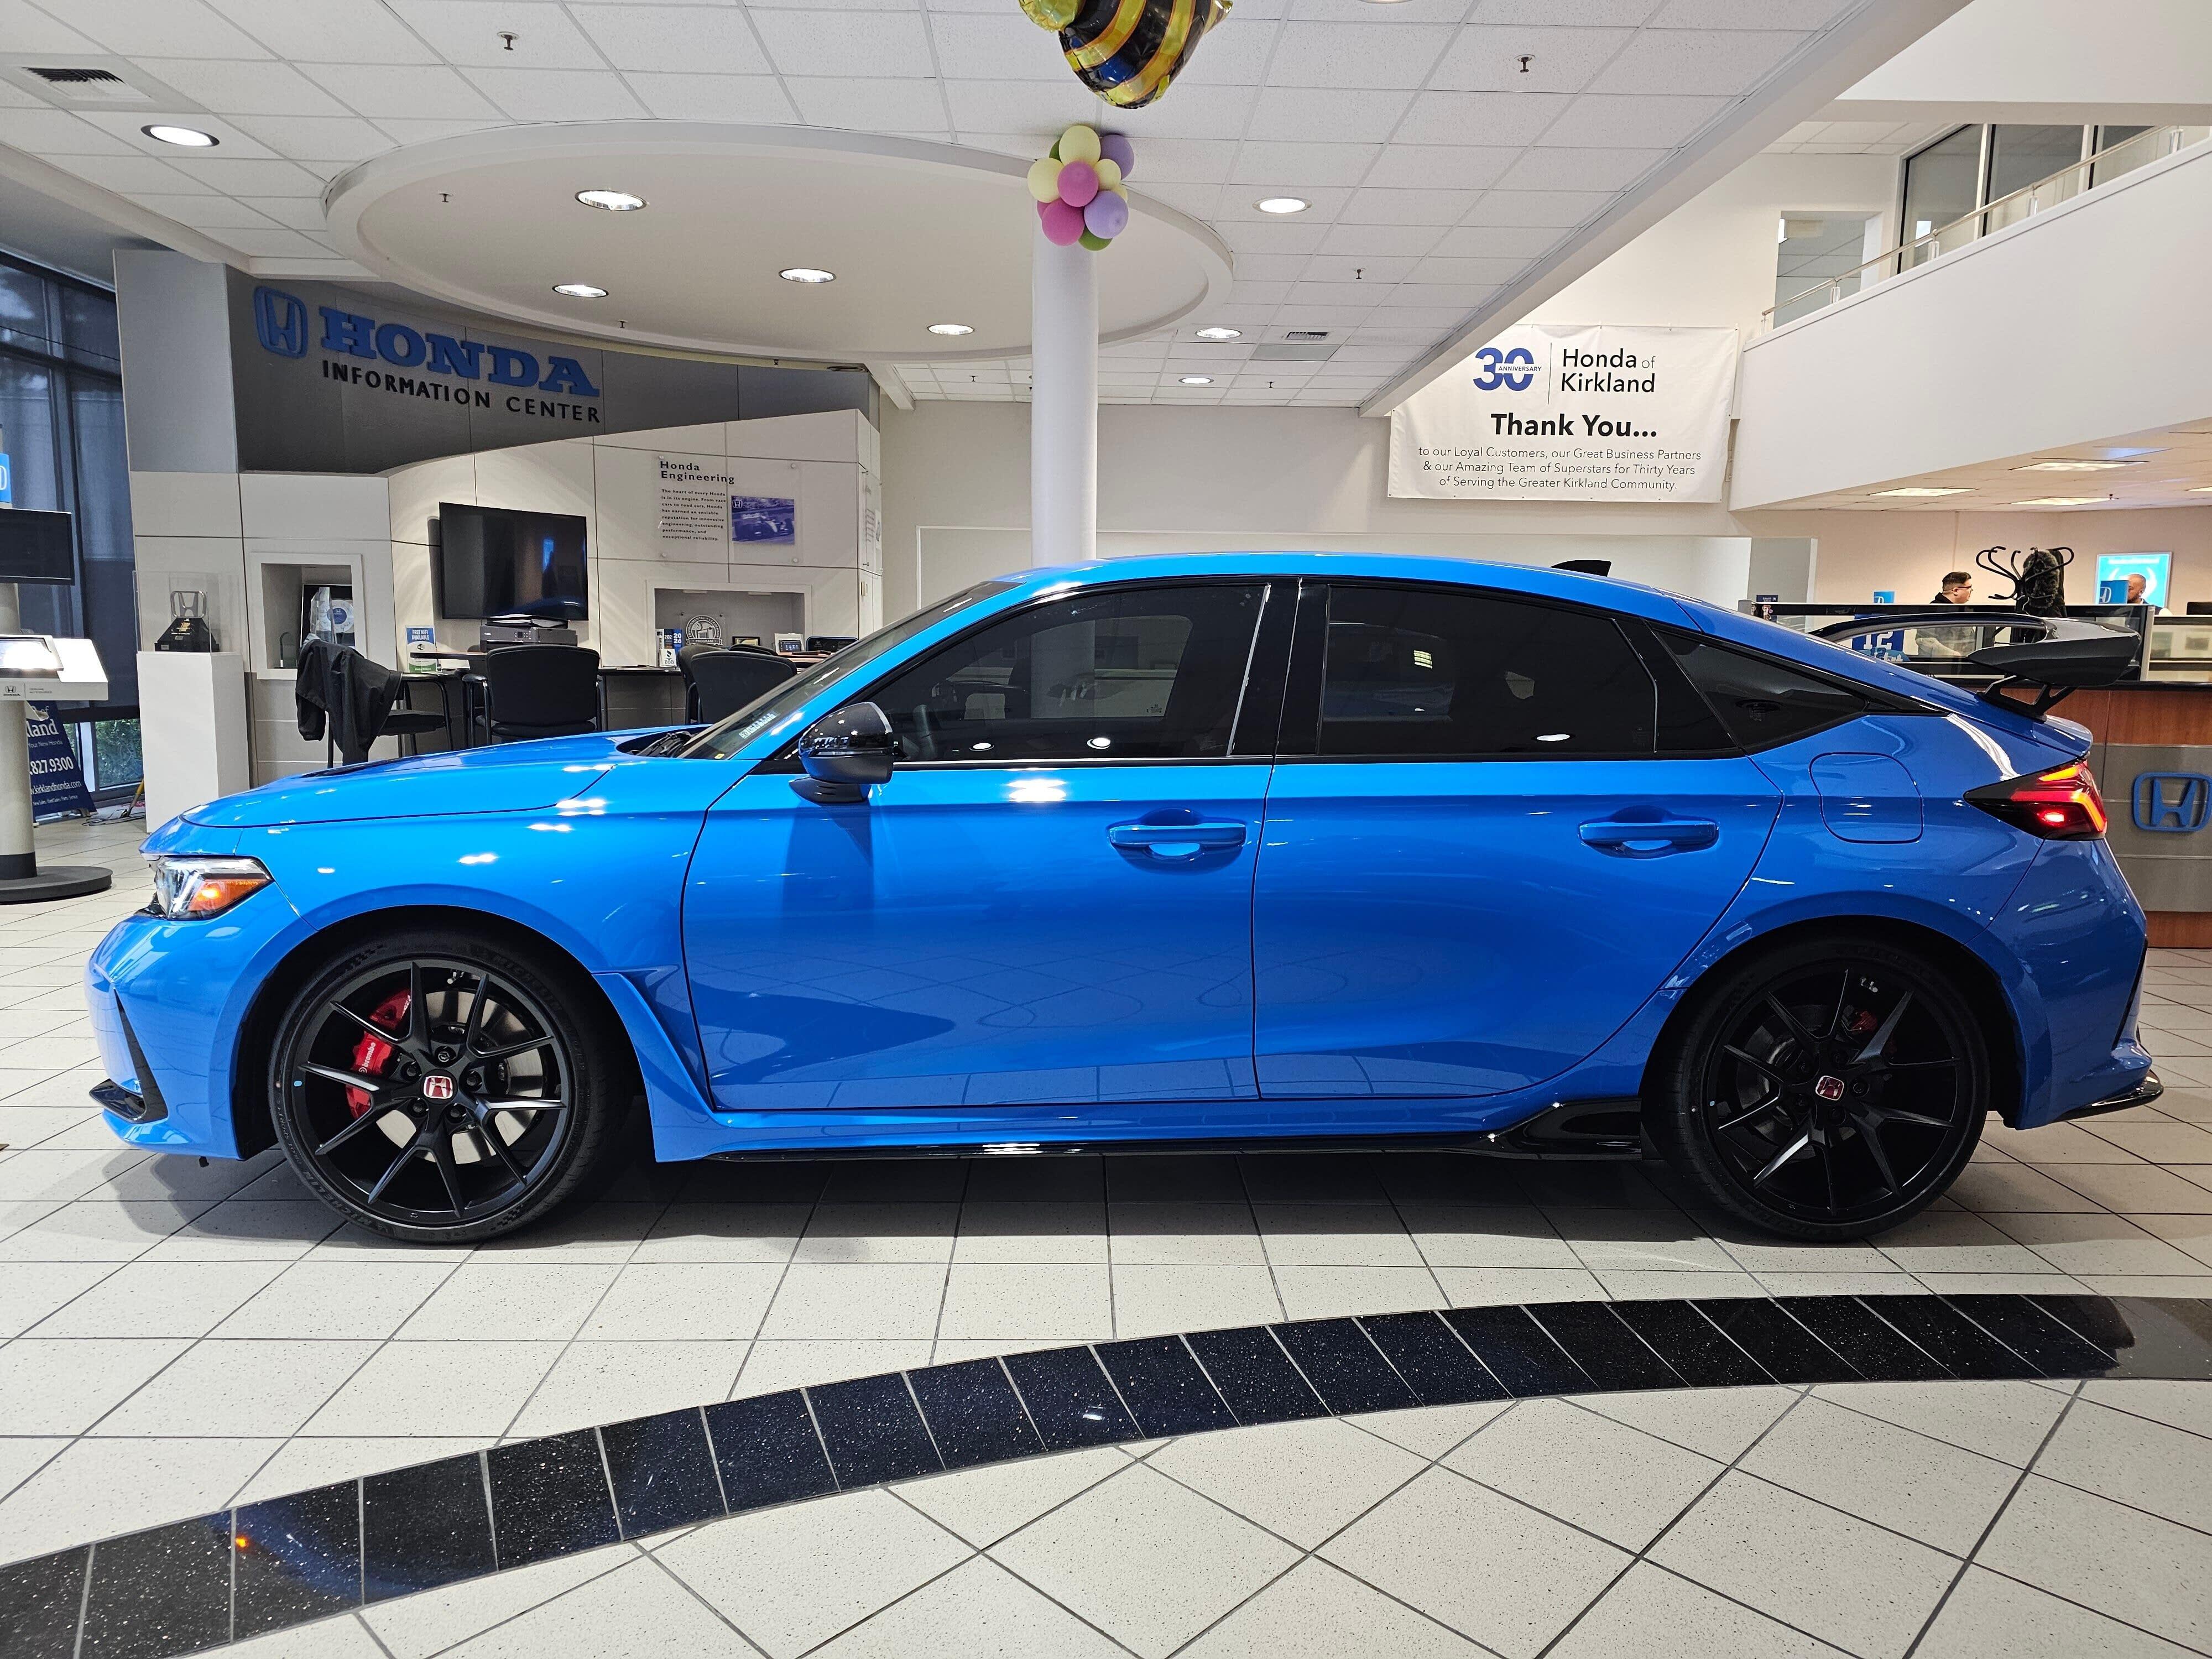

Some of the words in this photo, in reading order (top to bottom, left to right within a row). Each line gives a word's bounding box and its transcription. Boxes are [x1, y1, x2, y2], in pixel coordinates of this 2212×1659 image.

[319, 306, 599, 397] HONDA
[1563, 348, 1637, 368] Honda
[1641, 356, 1656, 369] of
[1473, 347, 1534, 392] 30
[322, 359, 490, 408] INFORMATION
[507, 397, 600, 423] CENTER
[1561, 372, 1655, 393] Kirkland
[1491, 413, 1575, 436] Thank
[1581, 415, 1657, 437] You...
[1418, 447, 1430, 456] to
[1454, 447, 1483, 459] Loyal
[1486, 447, 1547, 459] Customers,
[1573, 448, 1603, 458] Great
[1606, 449, 1654, 459] Business
[1658, 450, 1702, 460] Partners
[660, 461, 700, 471] Honda
[1423, 460, 1431, 471] &
[1455, 461, 1504, 474] Amazing
[1507, 462, 1536, 472] Team
[1540, 462, 1552, 473] of
[1554, 463, 1611, 475] Superstars
[1615, 463, 1630, 473] for
[1633, 464, 1663, 477] Thirty
[1666, 465, 1695, 474] Years
[661, 471, 734, 484] Engineering
[1439, 476, 1451, 486] of
[1453, 476, 1494, 489] Serving
[1498, 477, 1515, 487] the
[1519, 477, 1560, 488] Greater
[1563, 477, 1608, 488] Kirkland
[1611, 478, 1677, 492] Community.
[362, 1042, 376, 1068] brembo
